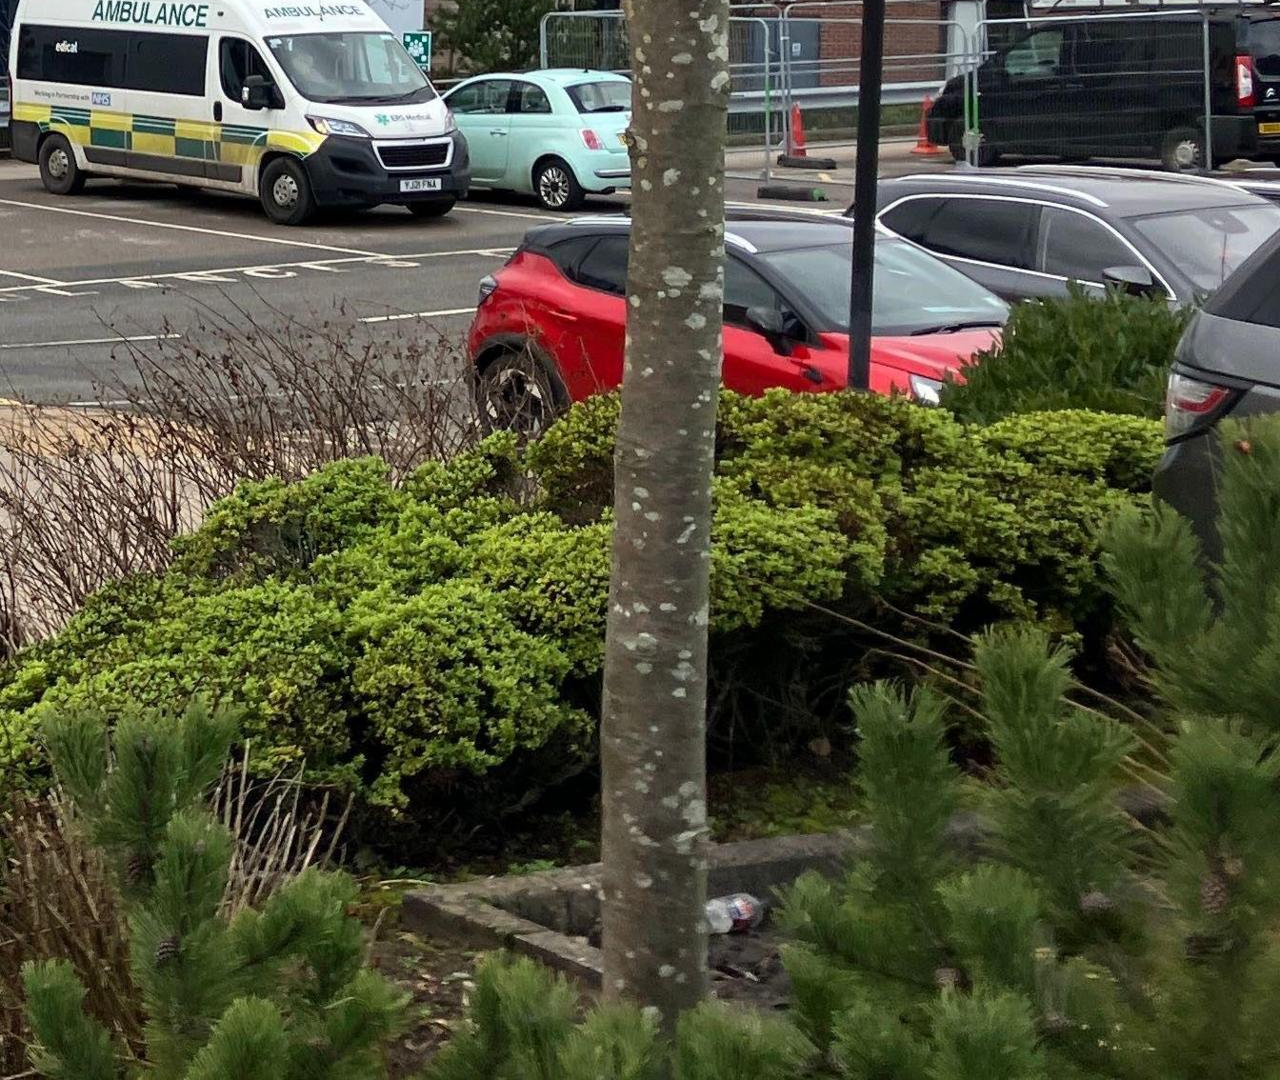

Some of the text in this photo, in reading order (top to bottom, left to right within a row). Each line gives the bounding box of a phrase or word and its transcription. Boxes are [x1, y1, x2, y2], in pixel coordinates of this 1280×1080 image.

[91, 0, 209, 27] AMBULANCE
[264, 5, 365, 19] AMBULANCE
[93, 92, 110, 106] NHS
